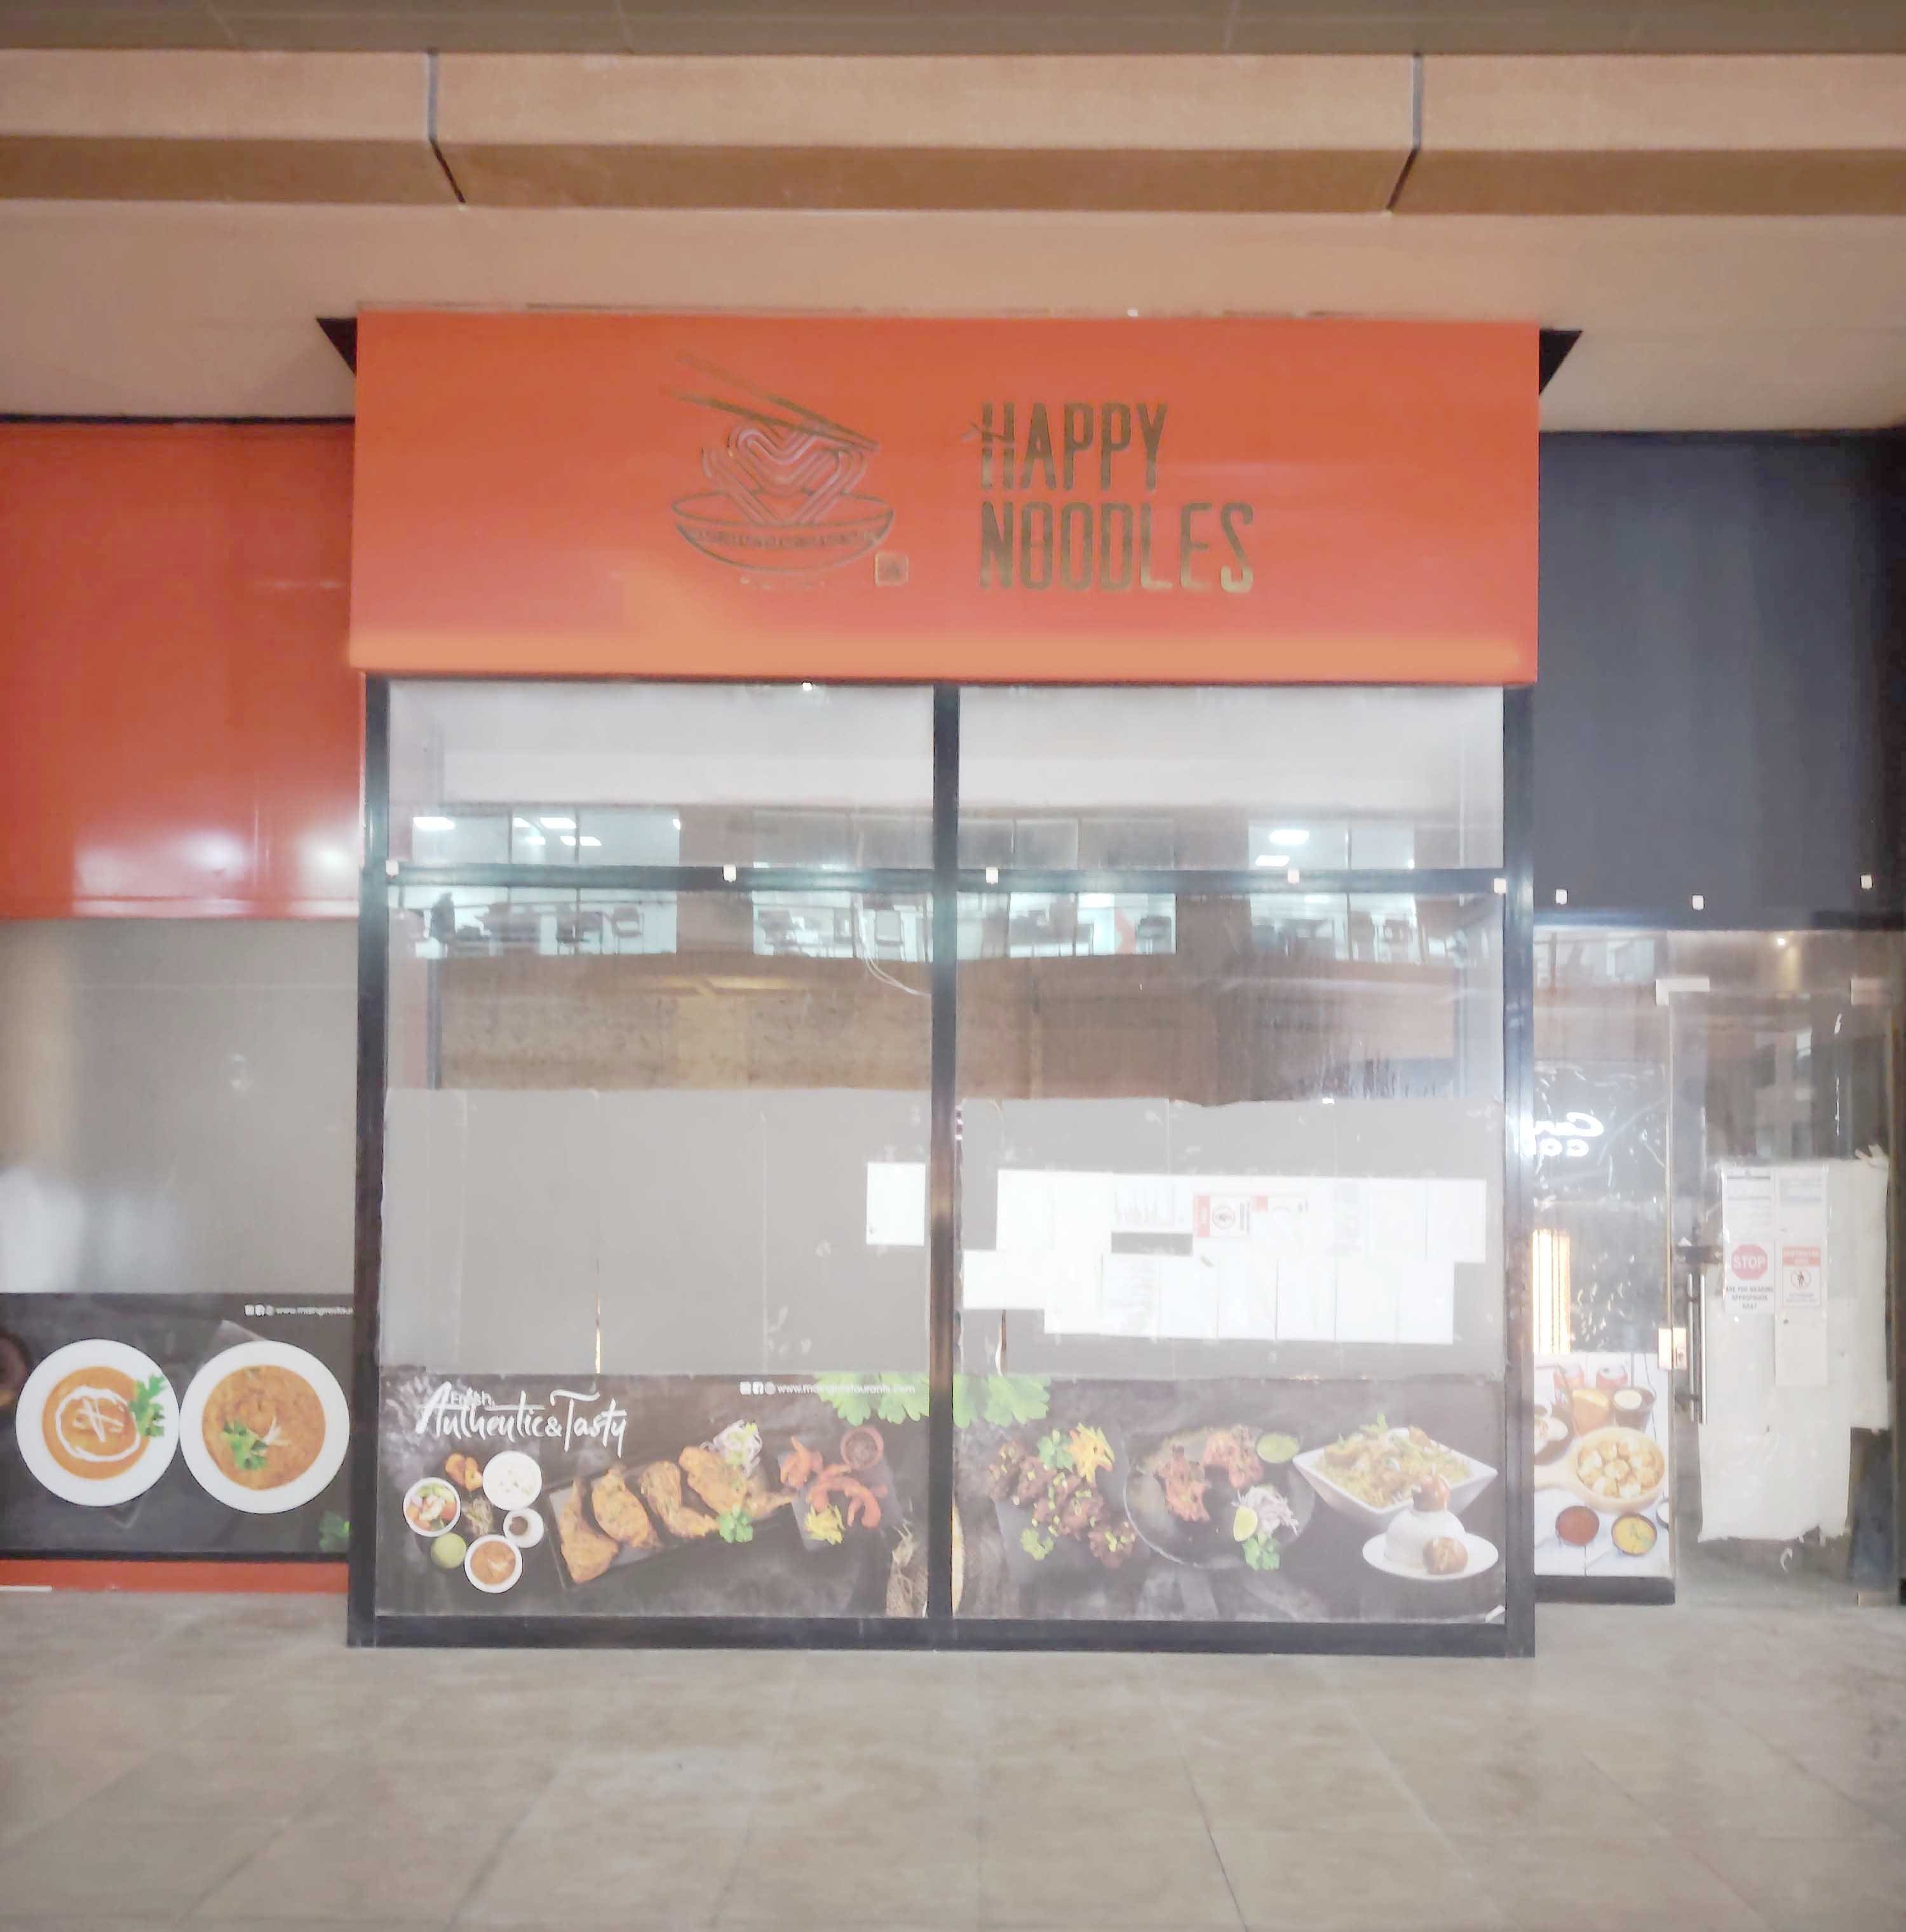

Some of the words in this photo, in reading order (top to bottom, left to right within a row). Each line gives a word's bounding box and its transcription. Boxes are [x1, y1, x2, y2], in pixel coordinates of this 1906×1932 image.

[980, 402, 1168, 491] HAPPY
[980, 501, 1255, 595] NOODLES
[1733, 1255, 1766, 1269] STOP
